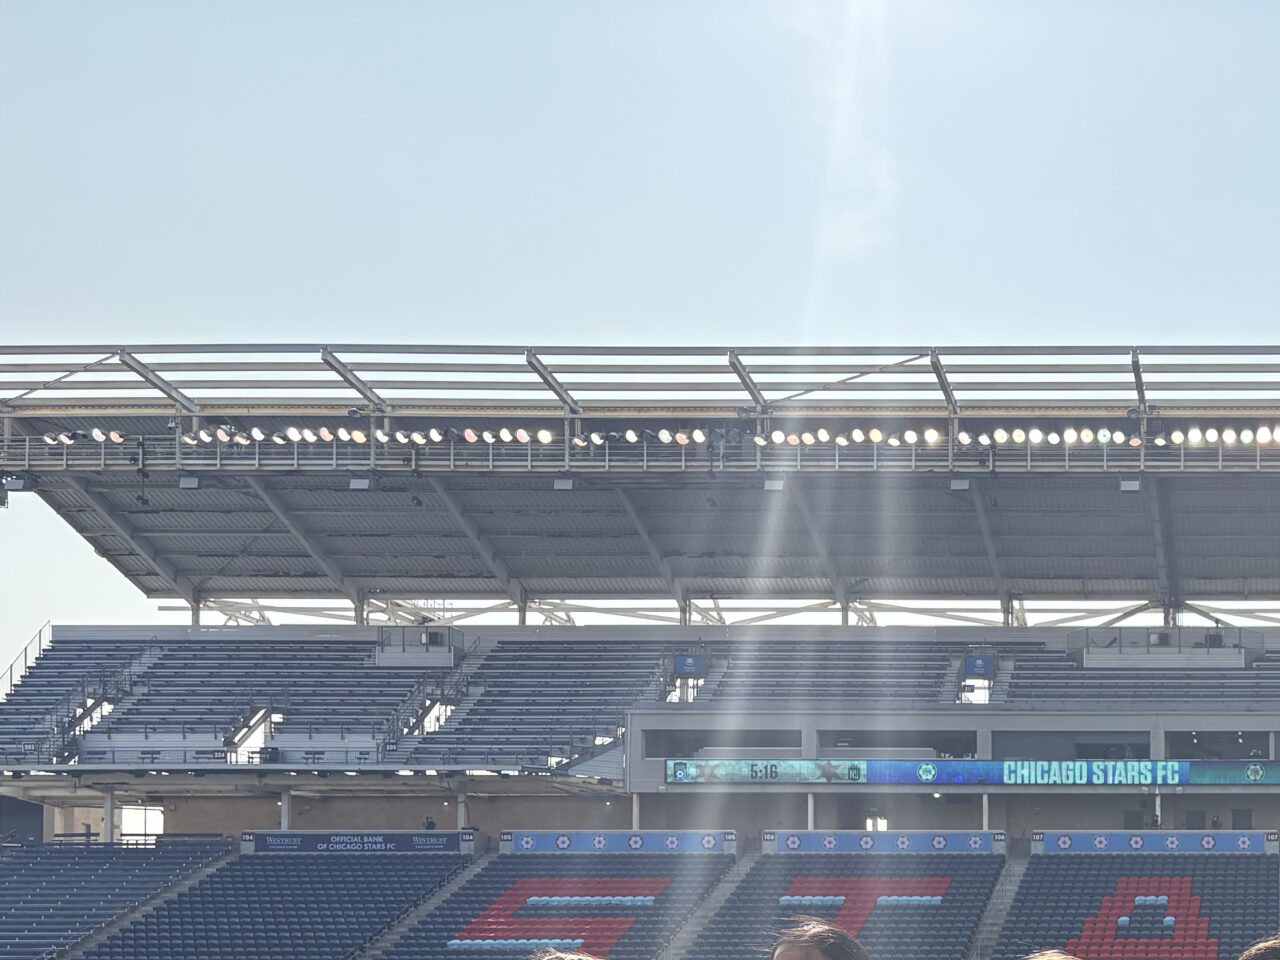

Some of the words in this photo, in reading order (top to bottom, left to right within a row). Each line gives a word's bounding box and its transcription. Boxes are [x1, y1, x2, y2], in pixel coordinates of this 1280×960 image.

[750, 763, 778, 779] 5:16
[1003, 761, 1087, 785] CHICAGO
[1092, 761, 1152, 785] STARS
[1157, 761, 1179, 785] FC
[266, 836, 302, 845] WINTRUST
[412, 836, 448, 845] WINTRUST
